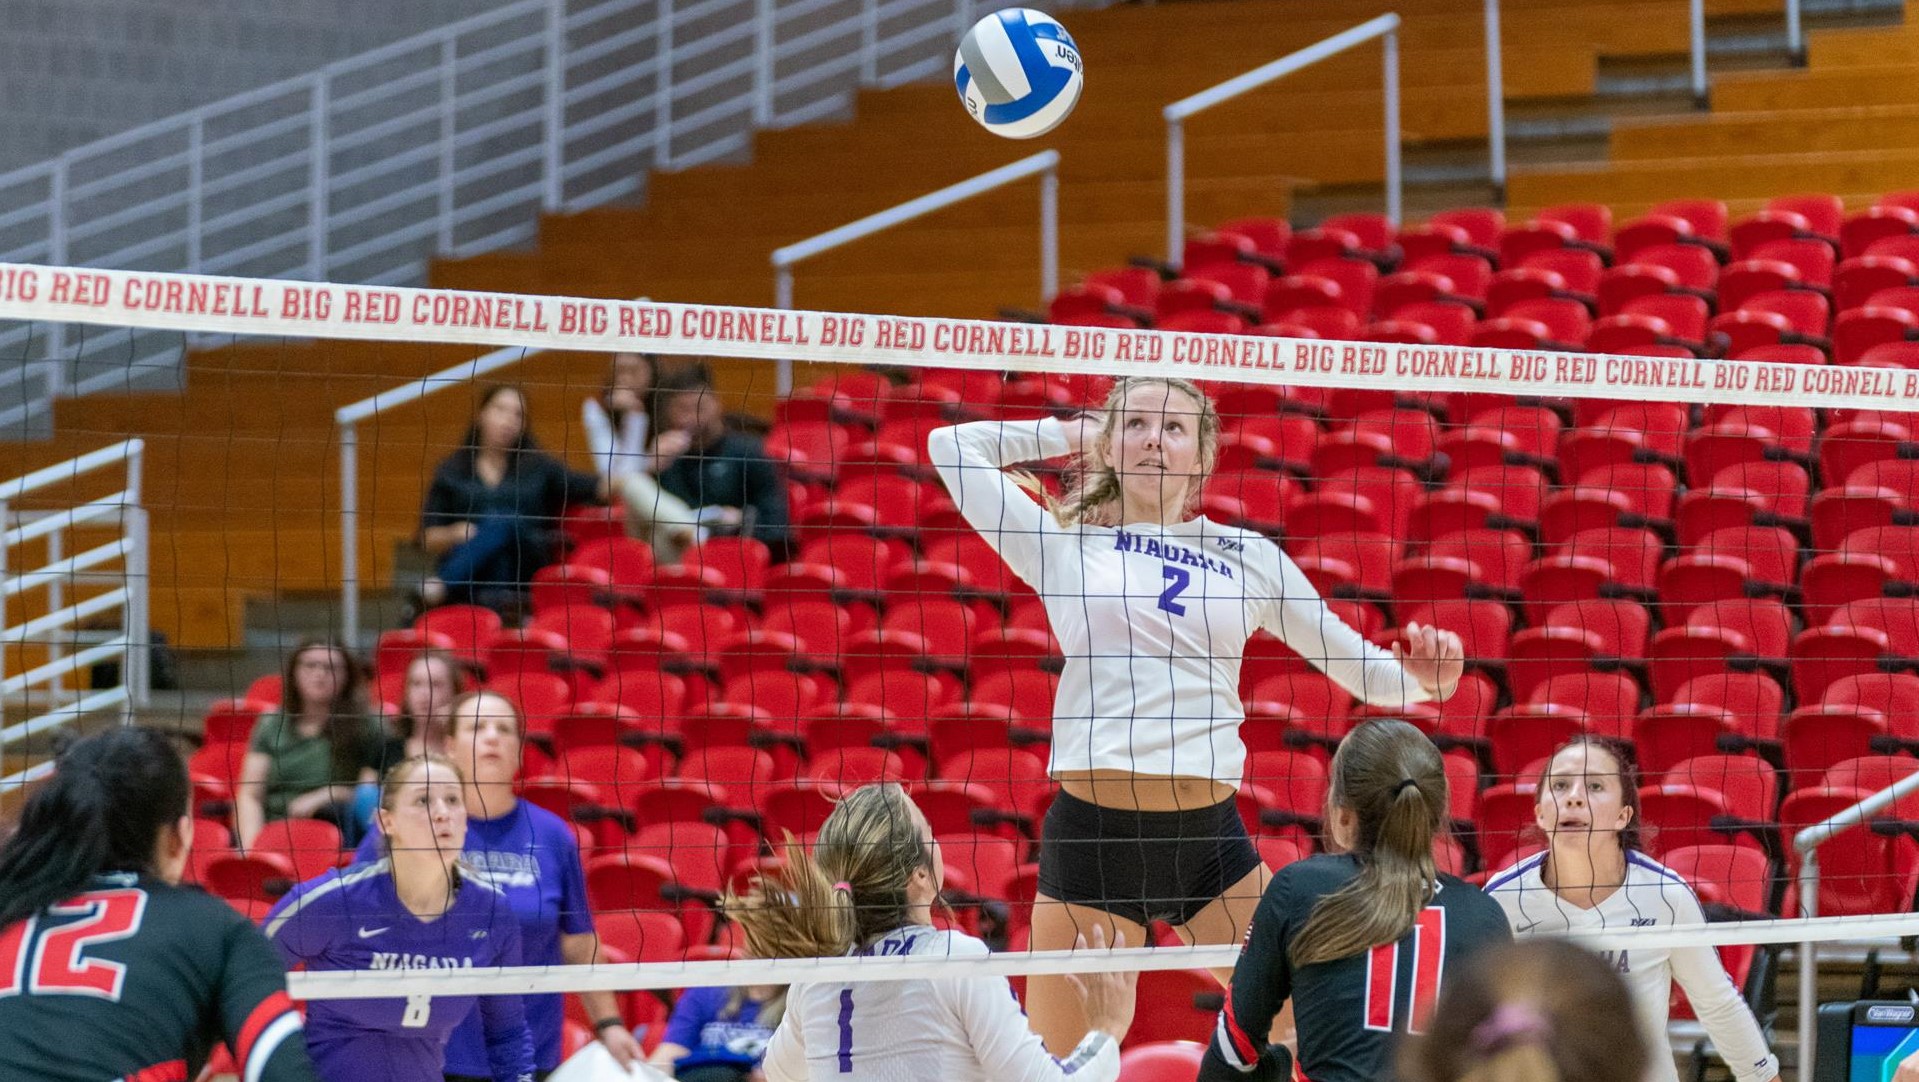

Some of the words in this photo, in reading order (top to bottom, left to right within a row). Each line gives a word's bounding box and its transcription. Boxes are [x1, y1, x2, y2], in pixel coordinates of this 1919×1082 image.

[0, 269, 38, 302] IG
[48, 273, 110, 307] RED
[123, 278, 268, 318] CORNELL
[281, 288, 331, 321] BIG
[343, 291, 401, 325] RED
[411, 294, 549, 332] CORNELL
[558, 303, 609, 336] BIG
[618, 306, 672, 339] RED
[681, 309, 810, 346] CORNELL
[819, 317, 866, 348] BIG
[875, 319, 926, 352] RED
[933, 323, 1056, 358] CORNELL
[1063, 329, 1107, 361] BIG
[1114, 333, 1164, 363] RED
[1171, 336, 1286, 370] CORNELL
[1294, 343, 1335, 373] BIG
[1339, 346, 1387, 376] RED
[1395, 349, 1501, 380] CORNELL
[1508, 354, 1548, 382] BIG
[1555, 356, 1598, 385] RED
[1605, 359, 1706, 389] CORNELL
[1713, 364, 1750, 391] BIG
[1753, 365, 1797, 394] RED
[1802, 368, 1897, 398] CORNELL
[1157, 565, 1190, 617] 2
[401, 993, 432, 1028] 8
[1363, 905, 1446, 1036] 11
[837, 988, 854, 1073] 1
